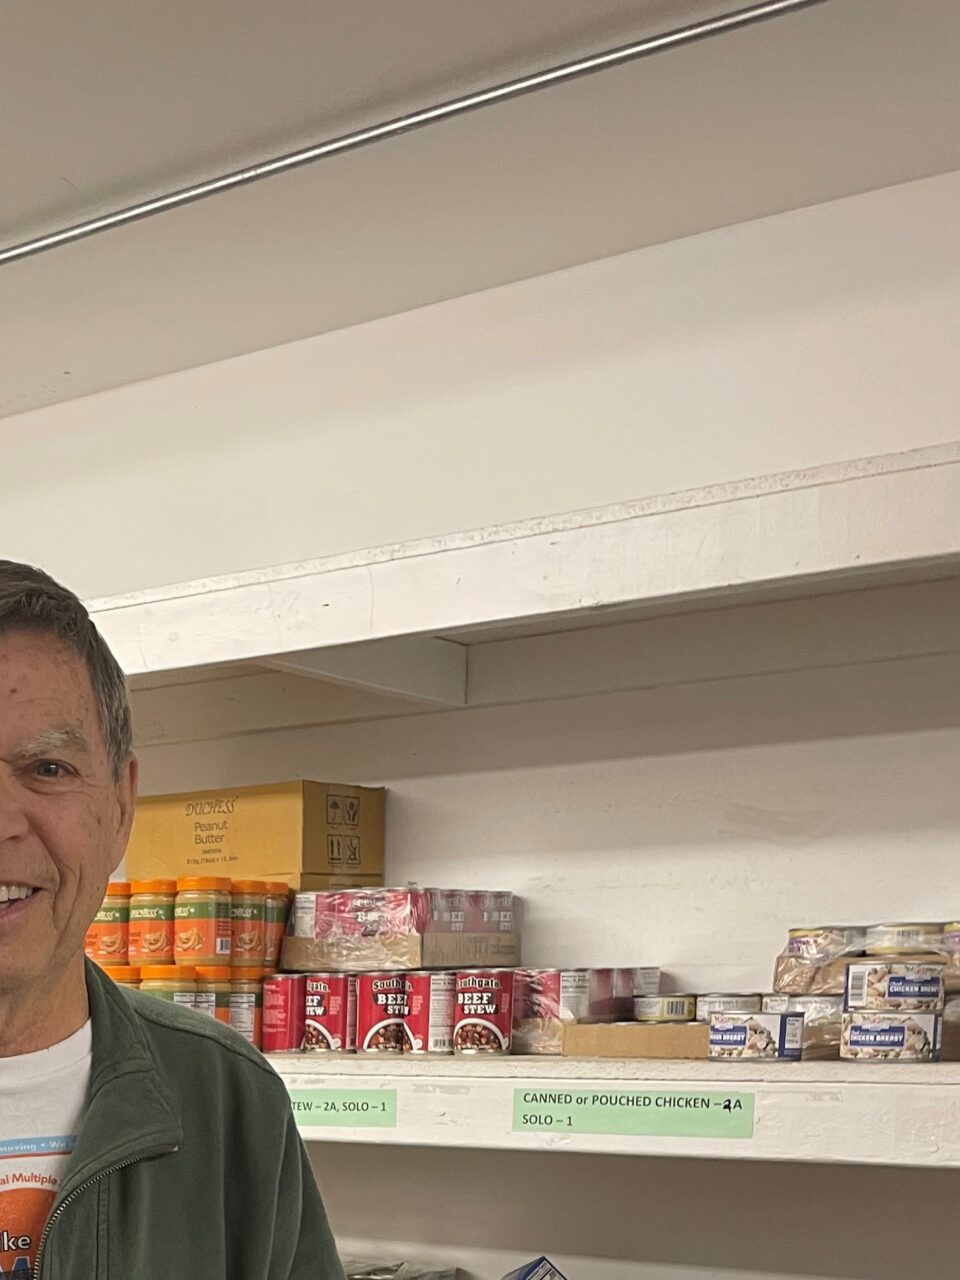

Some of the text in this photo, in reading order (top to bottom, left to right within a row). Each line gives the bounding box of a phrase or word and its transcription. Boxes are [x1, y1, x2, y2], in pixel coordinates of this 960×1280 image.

[194, 821, 229, 832] Peanut
[194, 834, 225, 845] Butter
[457, 993, 492, 1005] BEEF
[464, 1004, 496, 1014] STEW
[324, 1101, 340, 1113] 2A,
[342, 1101, 369, 1111] SOLO
[381, 1101, 386, 1111] 1
[523, 1093, 572, 1104] CANNED
[576, 1096, 588, 1105] or
[591, 1094, 651, 1107] POUCHED
[655, 1097, 710, 1109] CHICKEN
[522, 1114, 553, 1125] SOLO
[566, 1116, 573, 1126] 1
[12, 1173, 58, 1186] Multiple
